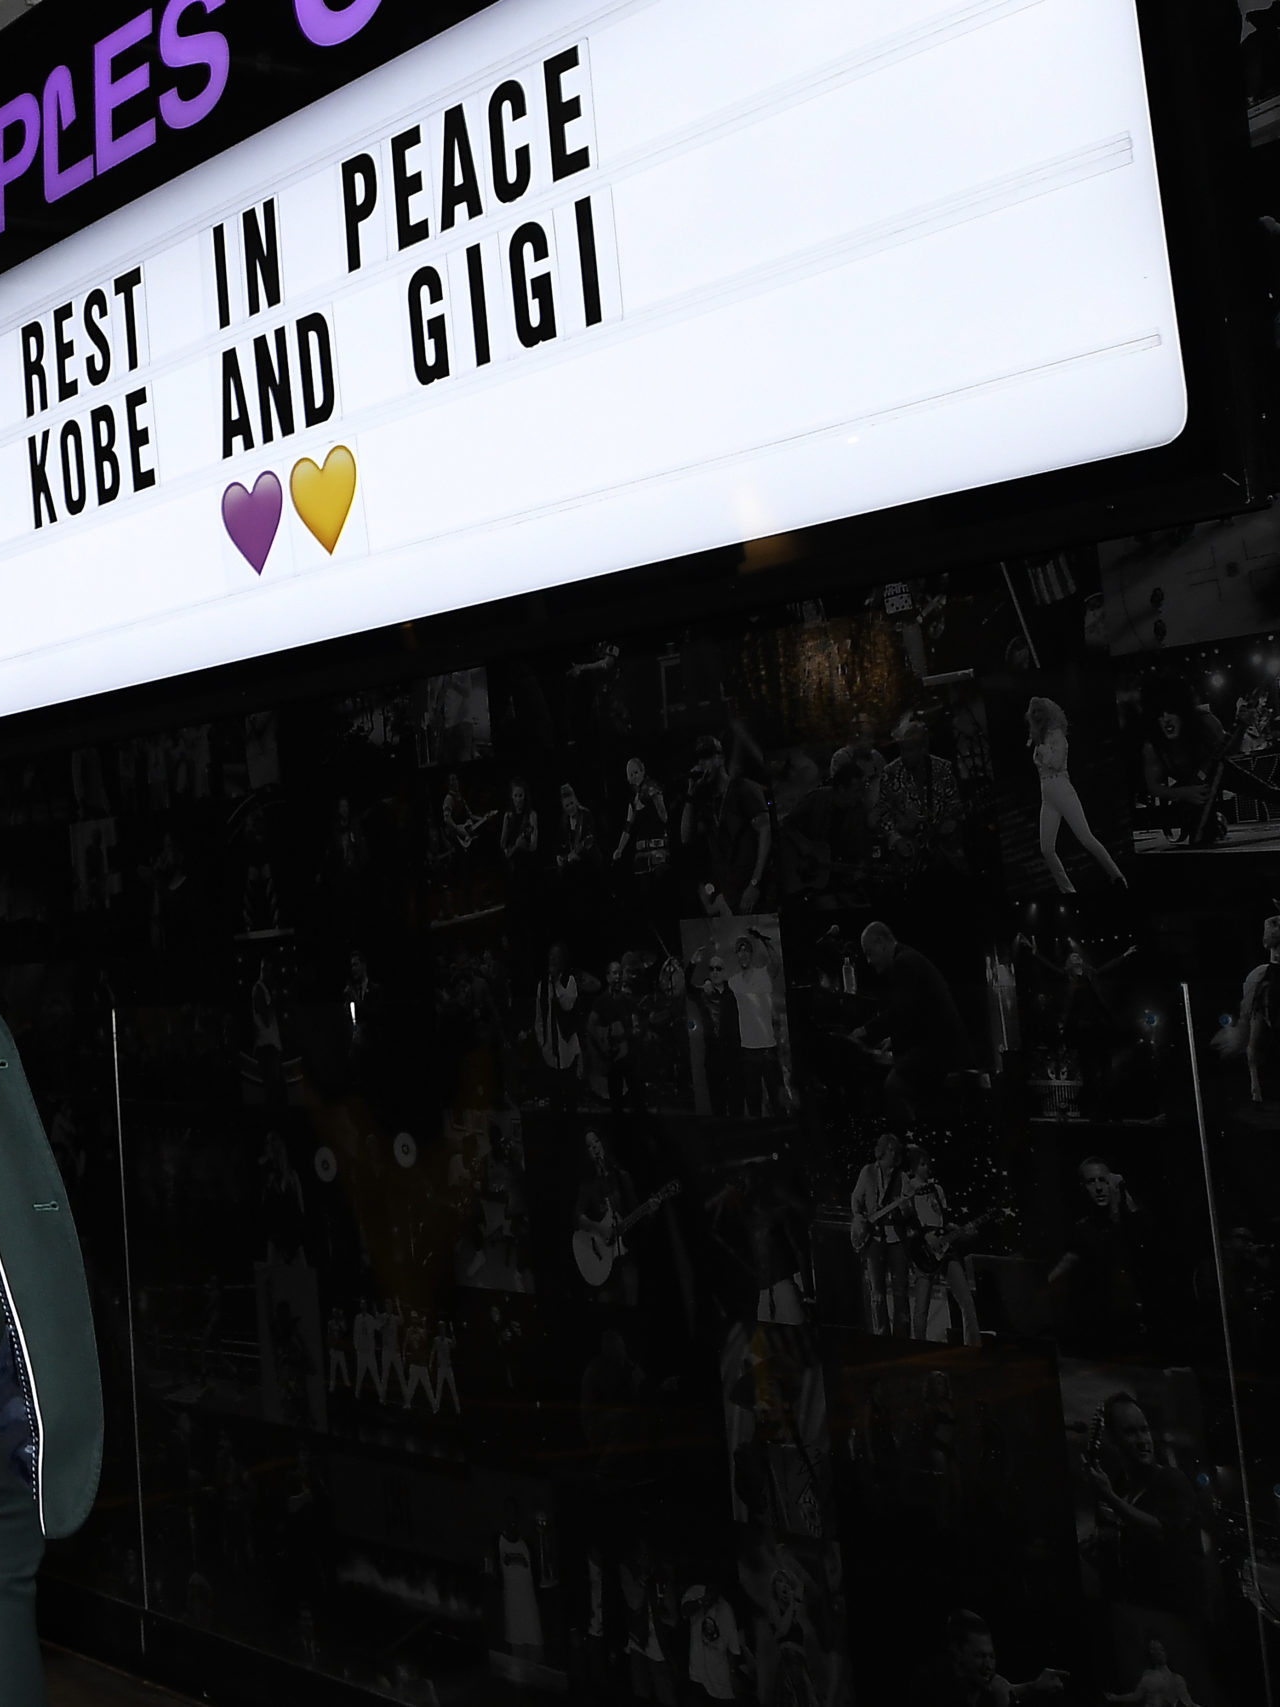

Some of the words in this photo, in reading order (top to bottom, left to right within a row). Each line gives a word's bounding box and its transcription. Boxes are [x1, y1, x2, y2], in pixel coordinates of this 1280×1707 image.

[21, 266, 142, 418] REST
[212, 197, 281, 330] IN
[341, 45, 590, 274] PEACE
[27, 386, 156, 530] KOBE
[222, 312, 335, 460] AND
[407, 195, 603, 386] GIGI
